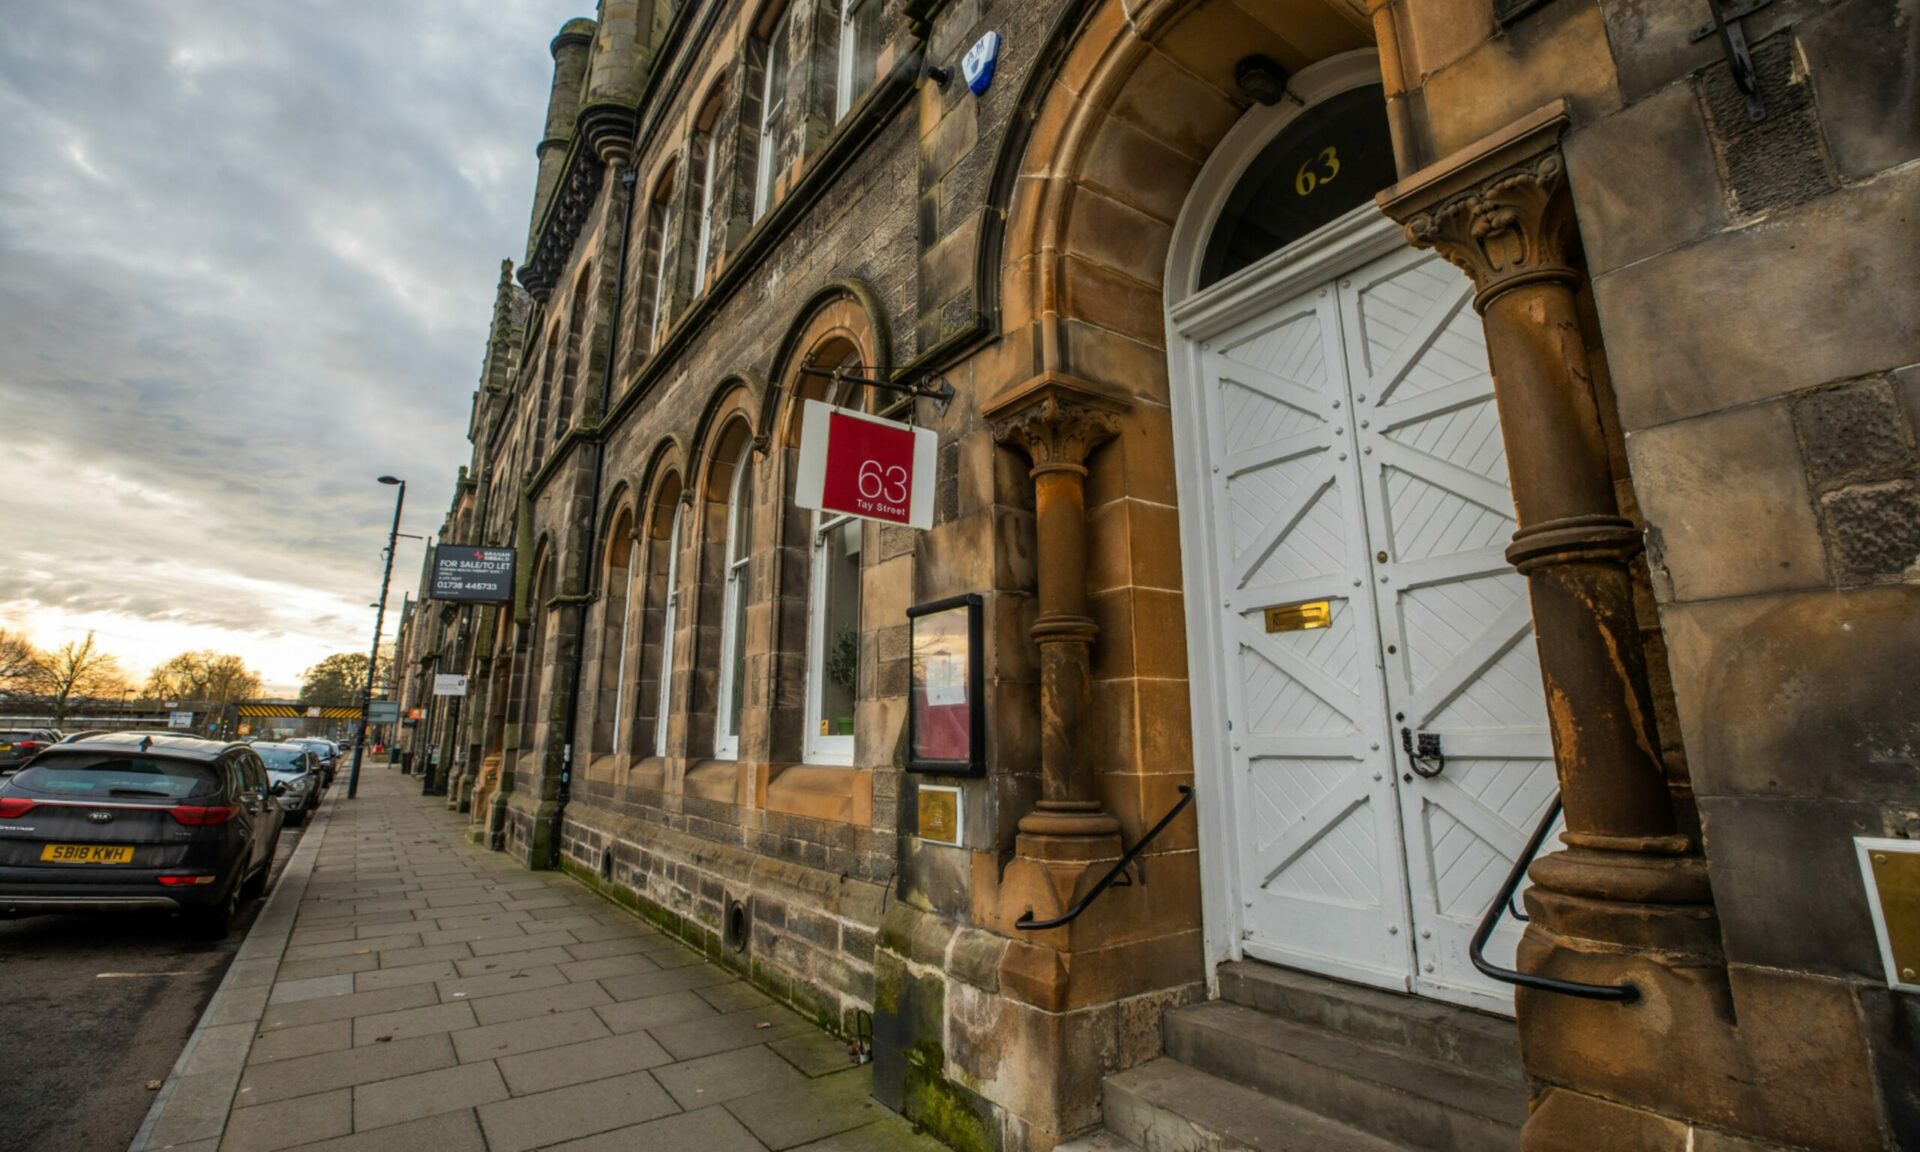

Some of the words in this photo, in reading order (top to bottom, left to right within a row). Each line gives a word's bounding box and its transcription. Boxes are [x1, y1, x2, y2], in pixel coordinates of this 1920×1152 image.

[1295, 145, 1340, 196] 63
[858, 459, 907, 504] 63
[856, 499, 873, 512] Tay
[876, 502, 905, 516] Street
[440, 560, 458, 568] FOR
[459, 560, 495, 569] SALE/TO
[496, 562, 511, 570] LET
[437, 581, 463, 590] 01738
[52, 846, 90, 860] SB18
[92, 846, 125, 860] KWH
